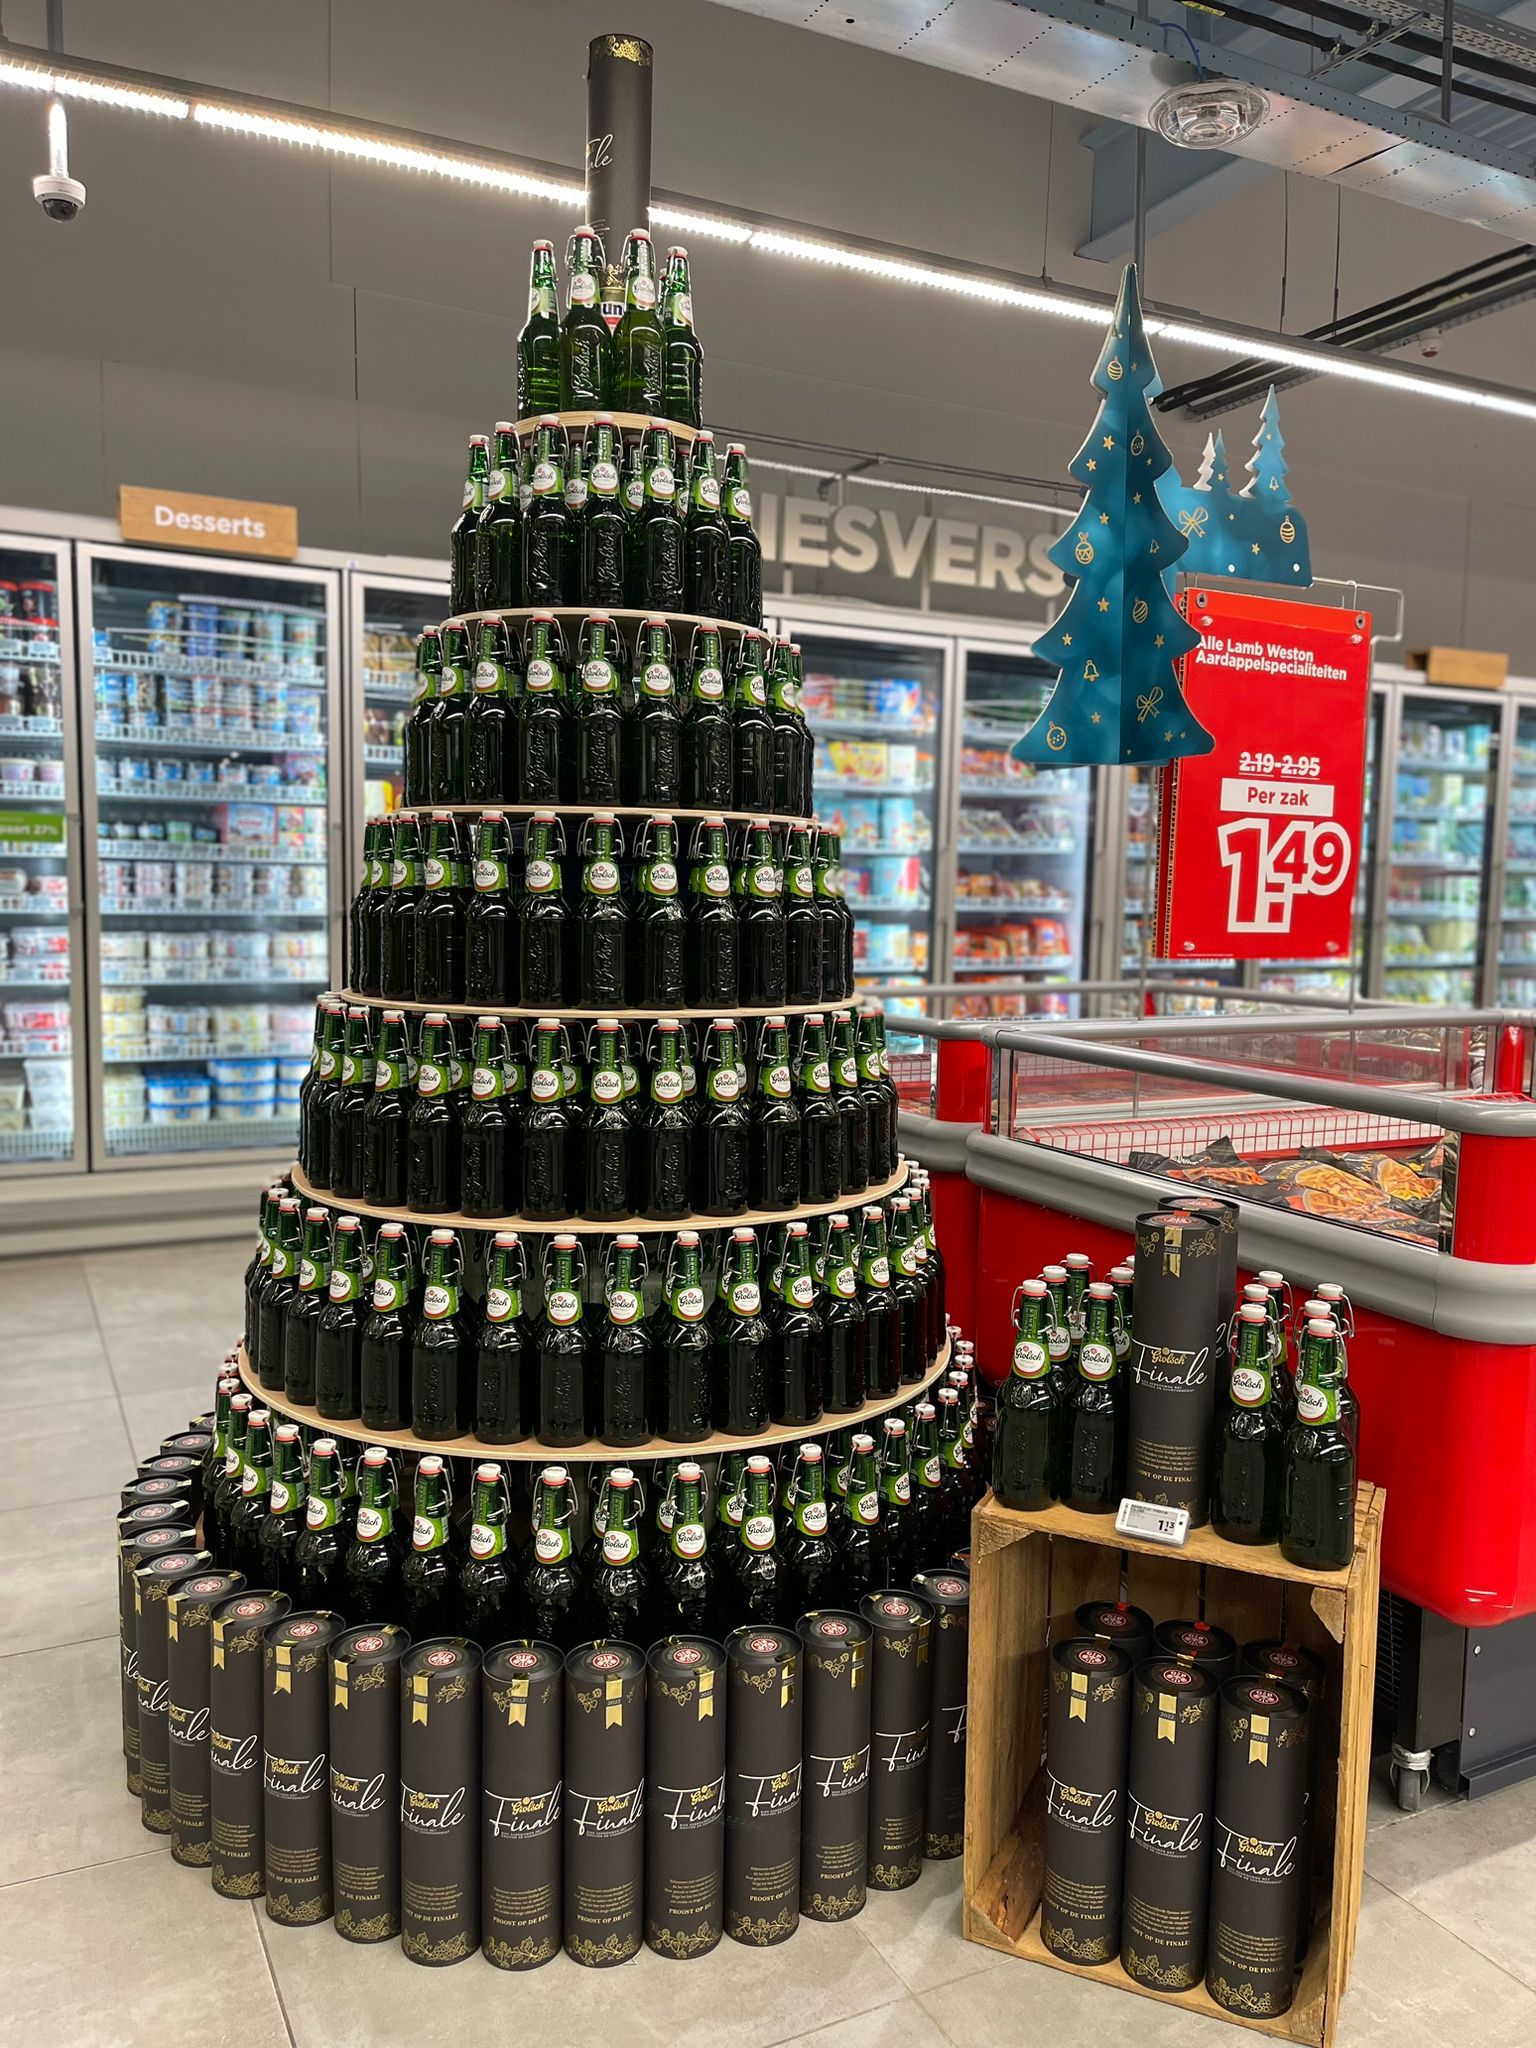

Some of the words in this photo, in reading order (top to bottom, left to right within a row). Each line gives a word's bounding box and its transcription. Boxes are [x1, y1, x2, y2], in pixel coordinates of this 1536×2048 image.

[592, 471, 617, 483] Grolsch
[154, 504, 267, 540] Desserts
[1197, 637, 1224, 652] Alle
[1227, 638, 1263, 658] Lamb
[1267, 643, 1314, 663] Weston
[585, 667, 610, 679] Grolsch
[1195, 648, 1348, 681] Aardappelspecialiteiten
[1247, 786, 1276, 806] Per
[1280, 787, 1310, 807] zak
[591, 867, 616, 880] Grolsch
[594, 1074, 619, 1094] Grolsch
[655, 1075, 681, 1094] Grolsch
[611, 1296, 636, 1310] Grolsch
[734, 1288, 759, 1302] Grolsch
[550, 1297, 576, 1311] Grolsch
[1014, 1346, 1043, 1361] Grolsch
[1082, 1349, 1110, 1364] Grolsch
[1131, 1337, 1209, 1386] Finale
[1150, 1349, 1188, 1366] Grolsch
[1232, 1373, 1263, 1390] Grolsch
[603, 1537, 629, 1550] Grolsch
[677, 1530, 704, 1546] Grolsch
[270, 1758, 301, 1775] Grolsch
[400, 1779, 466, 1828] Finale
[410, 1793, 442, 1809] Grolsch
[597, 1796, 630, 1815] Grolsch
[1046, 1767, 1117, 1828] Finale
[1060, 1787, 1093, 1807] Grolsch
[511, 1797, 546, 1815] Grolsch
[1128, 1789, 1204, 1852] Finale
[1145, 1811, 1181, 1831] Grolsch
[1215, 1816, 1298, 1878] Finale
[1237, 1838, 1276, 1857] Grolsch
[750, 1894, 774, 1902] PROOST
[517, 1918, 527, 1926] OP
